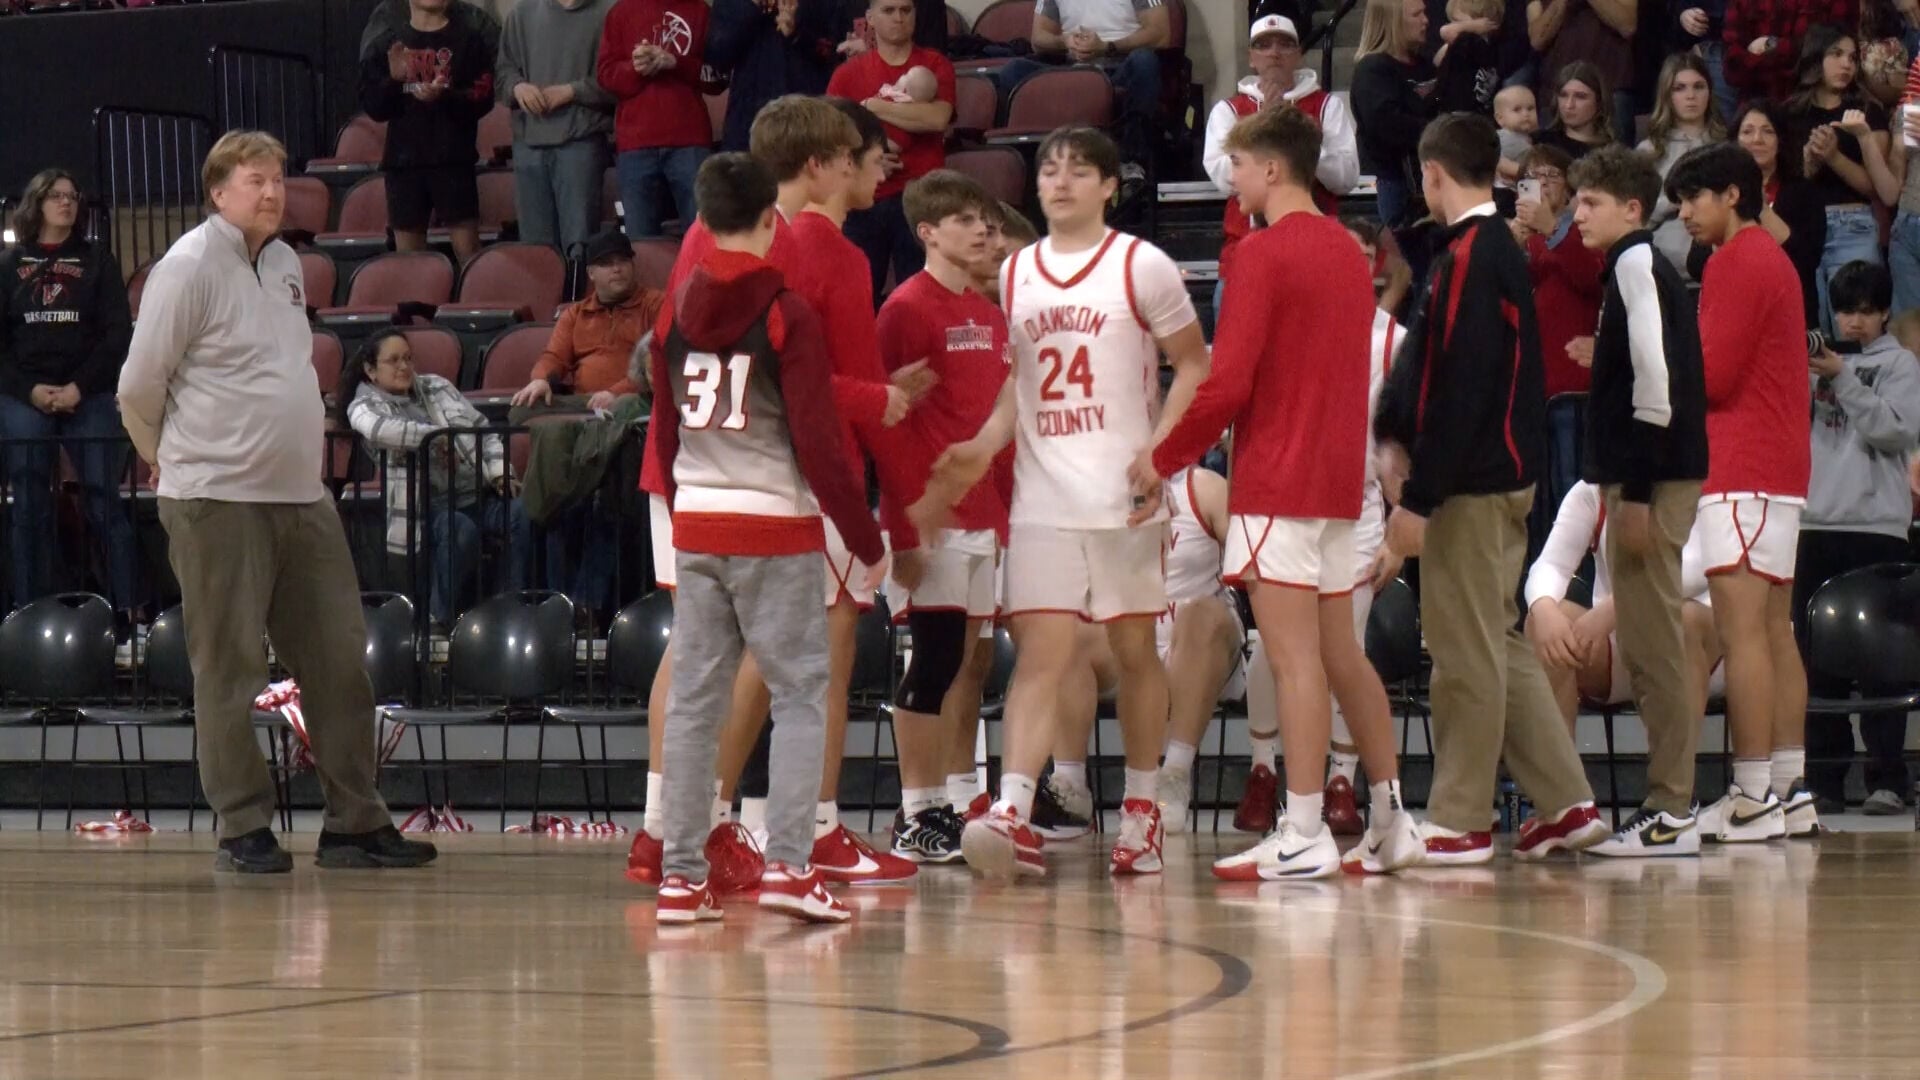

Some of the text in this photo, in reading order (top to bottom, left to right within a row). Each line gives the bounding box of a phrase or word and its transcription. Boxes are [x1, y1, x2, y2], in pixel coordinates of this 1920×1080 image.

[24, 311, 80, 324] BASKETBALL
[1024, 305, 1107, 343] DAWSON
[680, 351, 752, 431] 31
[1038, 345, 1094, 401] 24
[1036, 405, 1105, 437] COUNTY
